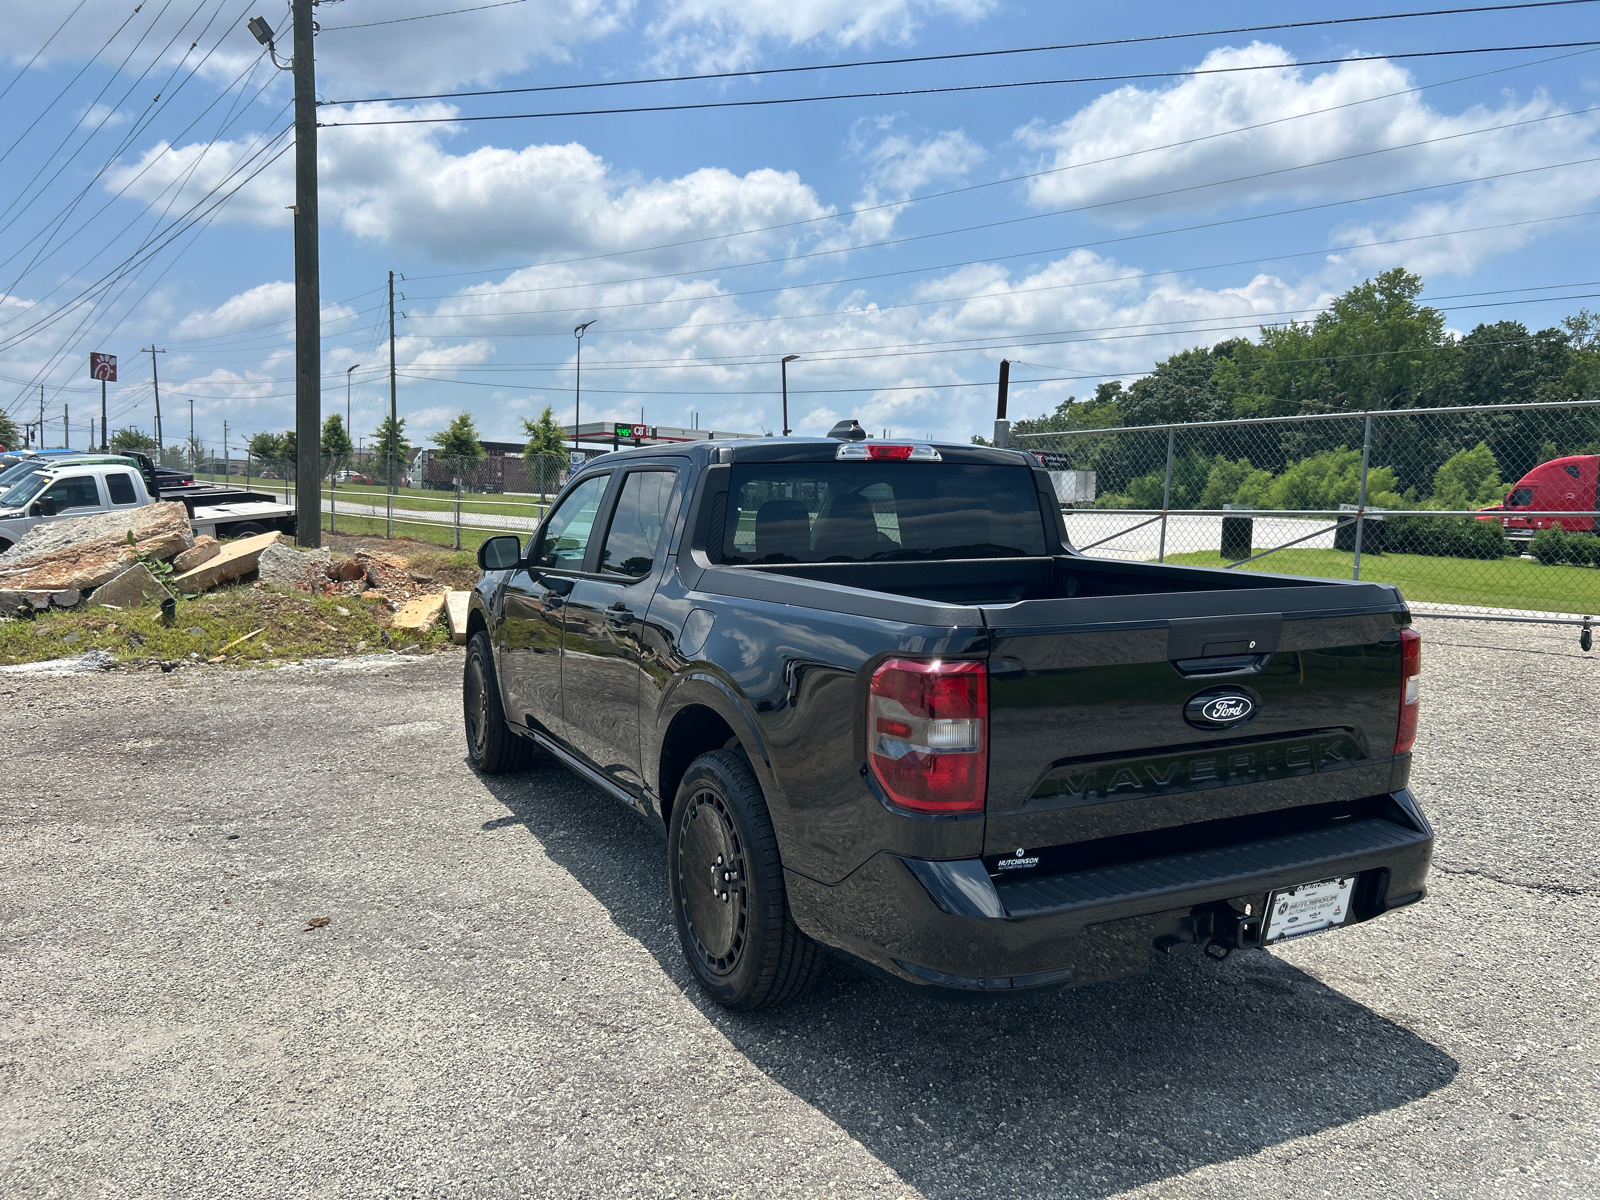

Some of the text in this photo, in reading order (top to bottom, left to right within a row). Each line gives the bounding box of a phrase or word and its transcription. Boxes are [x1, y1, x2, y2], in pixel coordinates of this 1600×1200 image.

[633, 426, 645, 436] QT
[1212, 699, 1243, 718] Ford
[1057, 739, 1343, 798] MAVERICK
[998, 857, 1039, 867] HUTCHINSON
